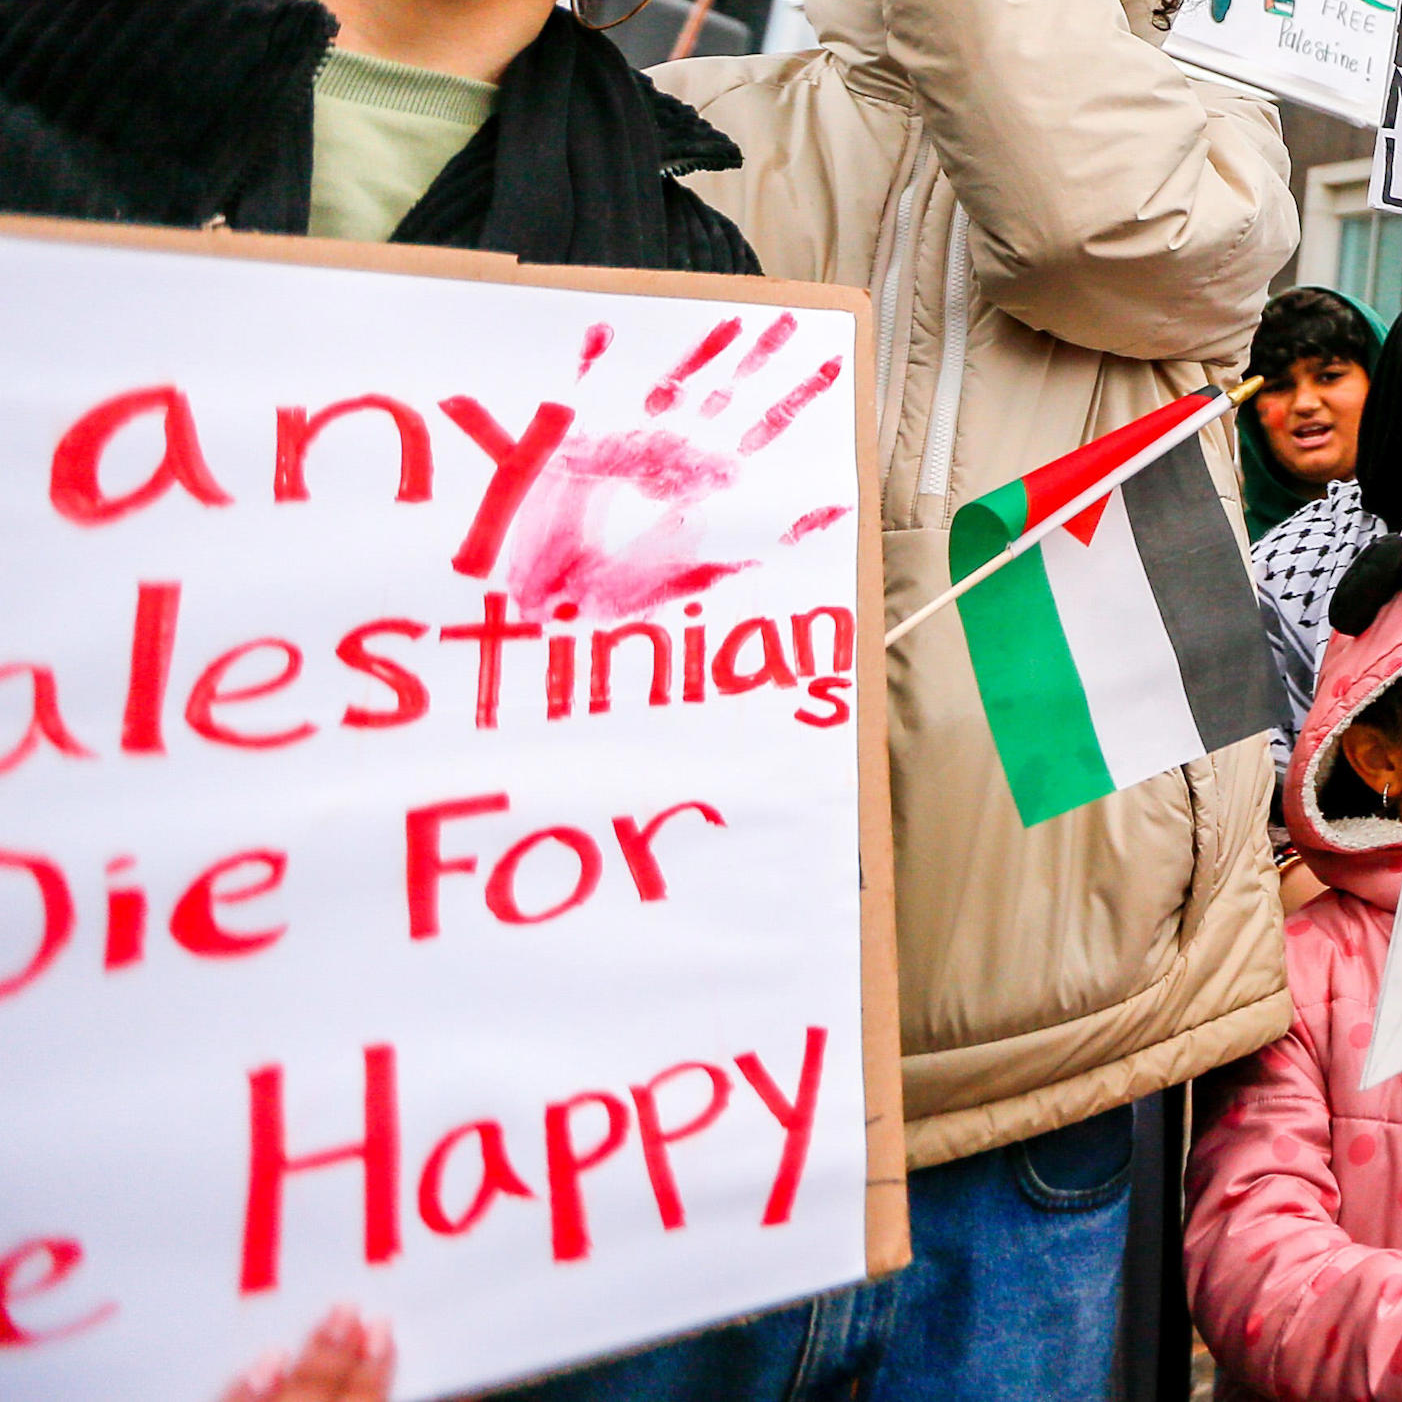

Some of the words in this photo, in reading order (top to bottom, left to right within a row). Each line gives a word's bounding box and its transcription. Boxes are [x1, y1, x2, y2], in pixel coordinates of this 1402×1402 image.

[49, 383, 576, 581] any
[405, 790, 727, 943] For
[237, 1024, 829, 1297] Happy
